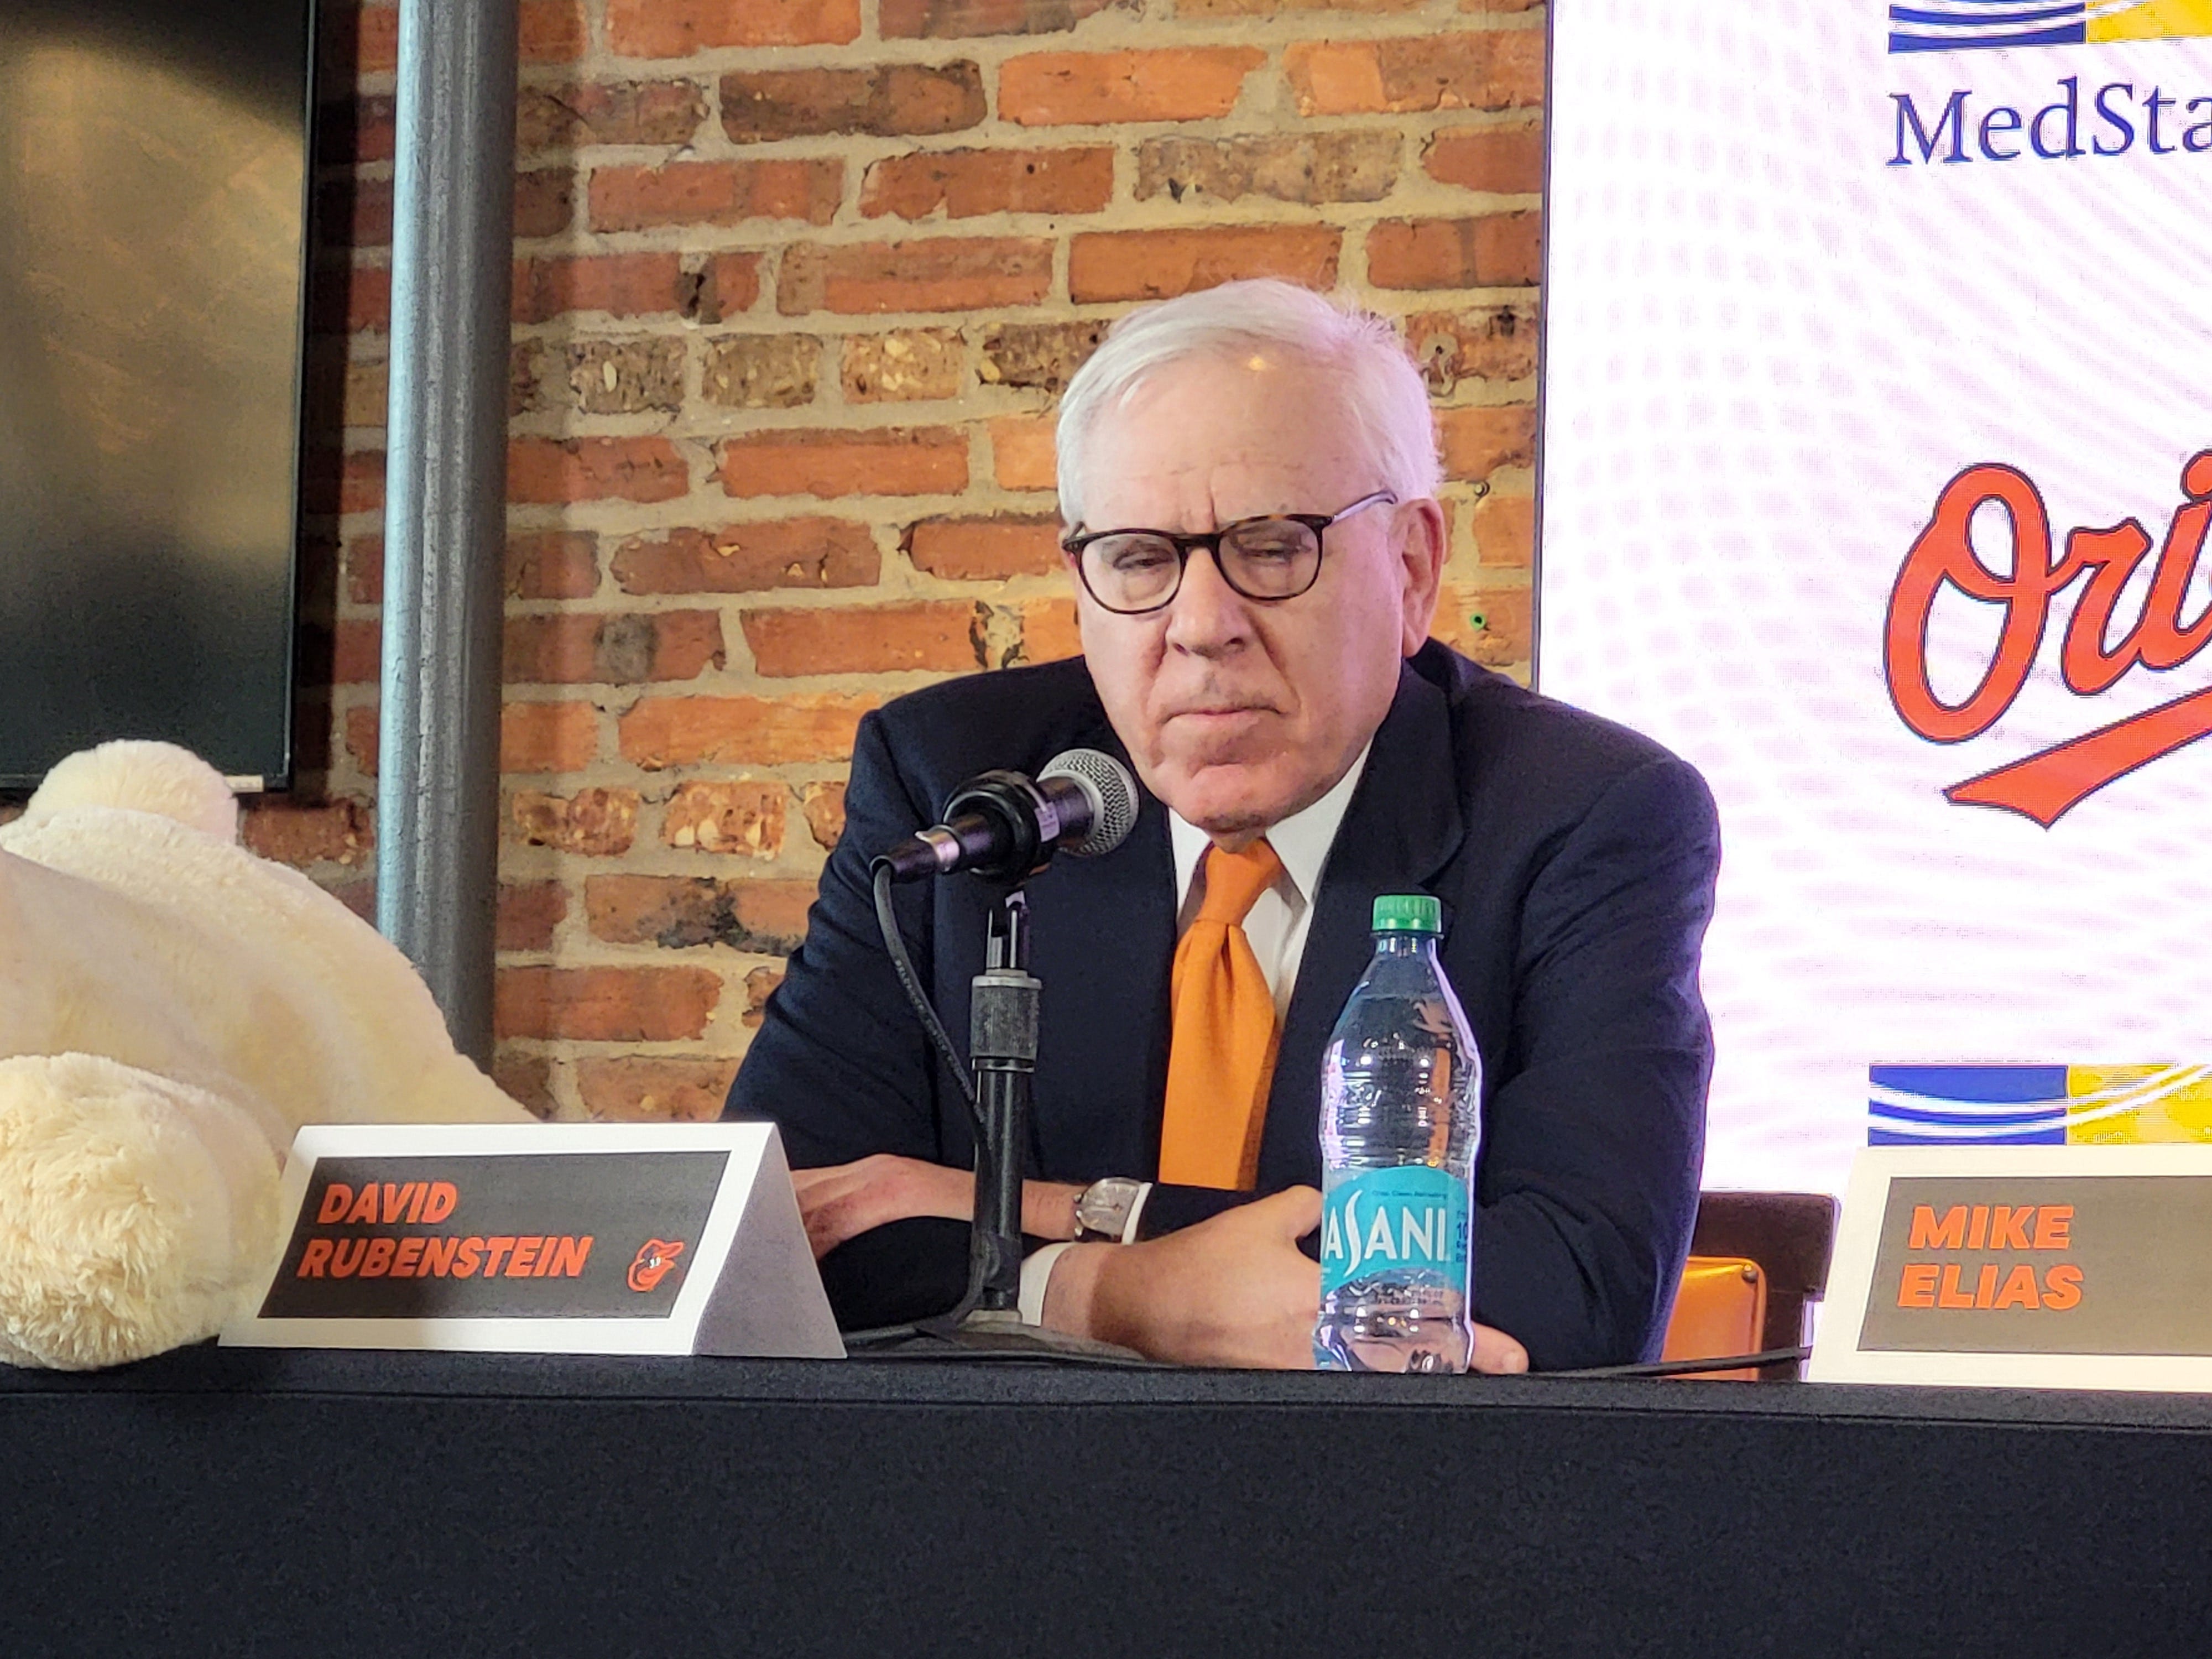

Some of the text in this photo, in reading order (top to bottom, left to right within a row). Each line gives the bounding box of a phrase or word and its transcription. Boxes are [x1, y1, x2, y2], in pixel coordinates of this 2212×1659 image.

[1886, 75, 2212, 165] MedSta
[316, 1181, 459, 1224] DAVID
[1322, 1190, 1447, 1278] ASANI
[1908, 1204, 2074, 1250] MIKE
[296, 1235, 594, 1279] RUBENSTEIN
[1897, 1264, 2084, 1311] ELIAS
